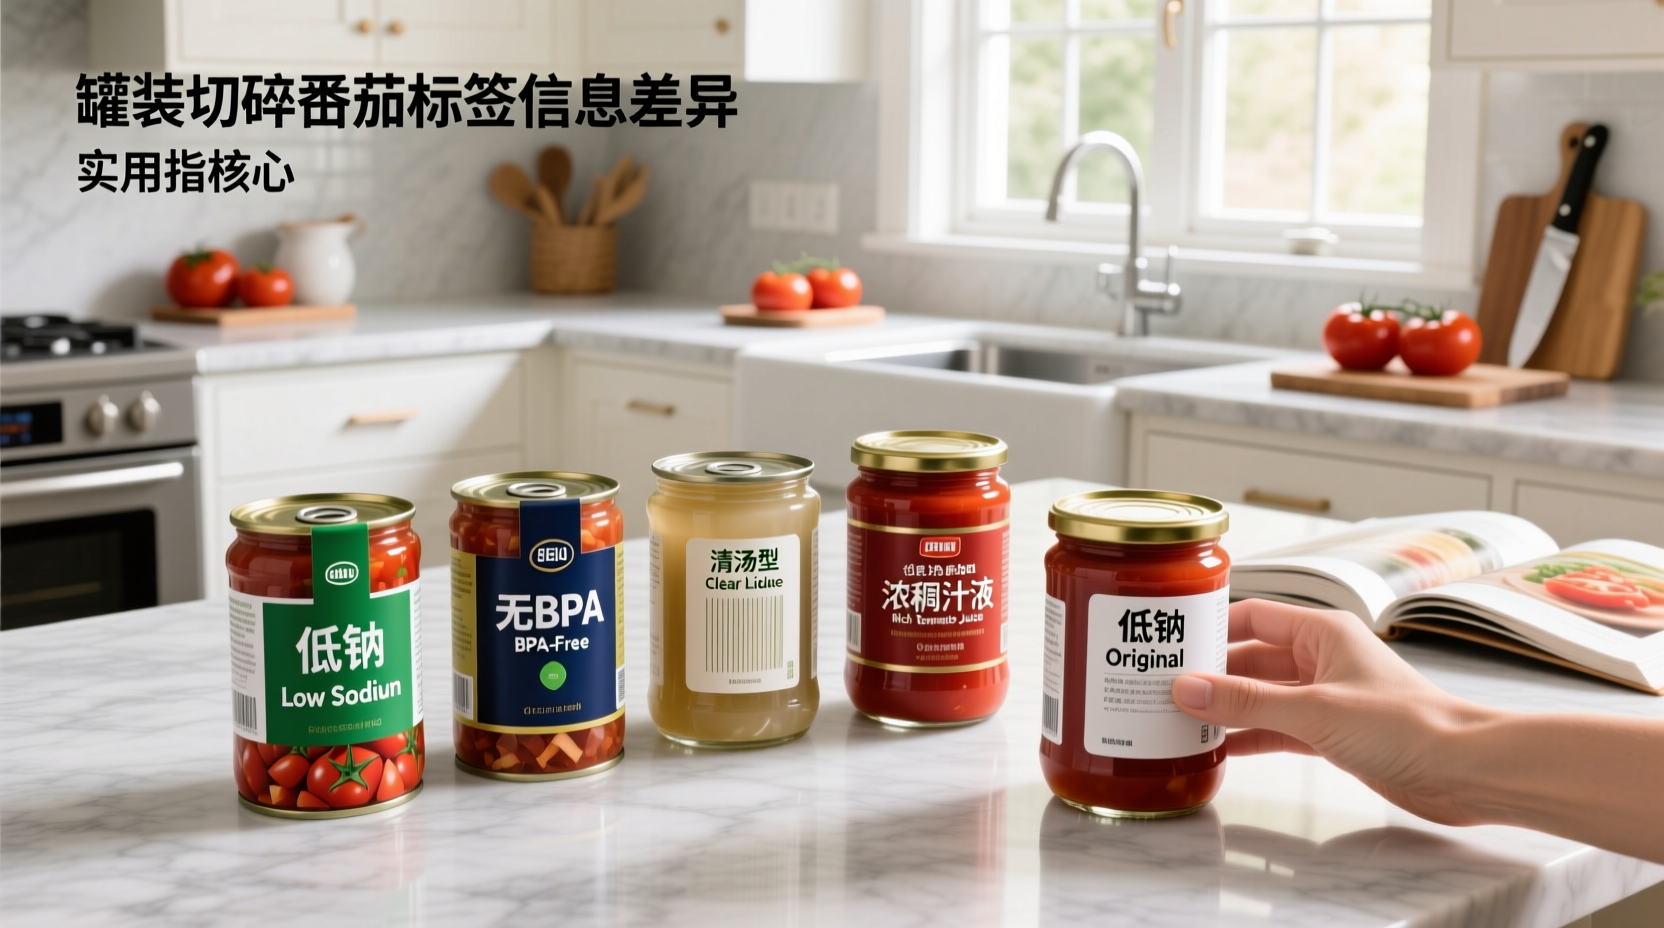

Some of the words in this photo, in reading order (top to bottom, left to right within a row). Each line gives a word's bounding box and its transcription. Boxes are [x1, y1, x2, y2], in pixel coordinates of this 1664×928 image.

[711, 547, 779, 573] 清汤型
[705, 576, 742, 590] Clear
[882, 575, 994, 613] 浓稠汁液
[496, 590, 605, 631] 无BPA
[1118, 609, 1186, 643] 低钠
[296, 621, 385, 674] 低钠
[515, 635, 589, 652] BPA-Free
[1106, 648, 1184, 672] Original
[282, 686, 325, 707] Low
[331, 679, 401, 706] Sodiun
